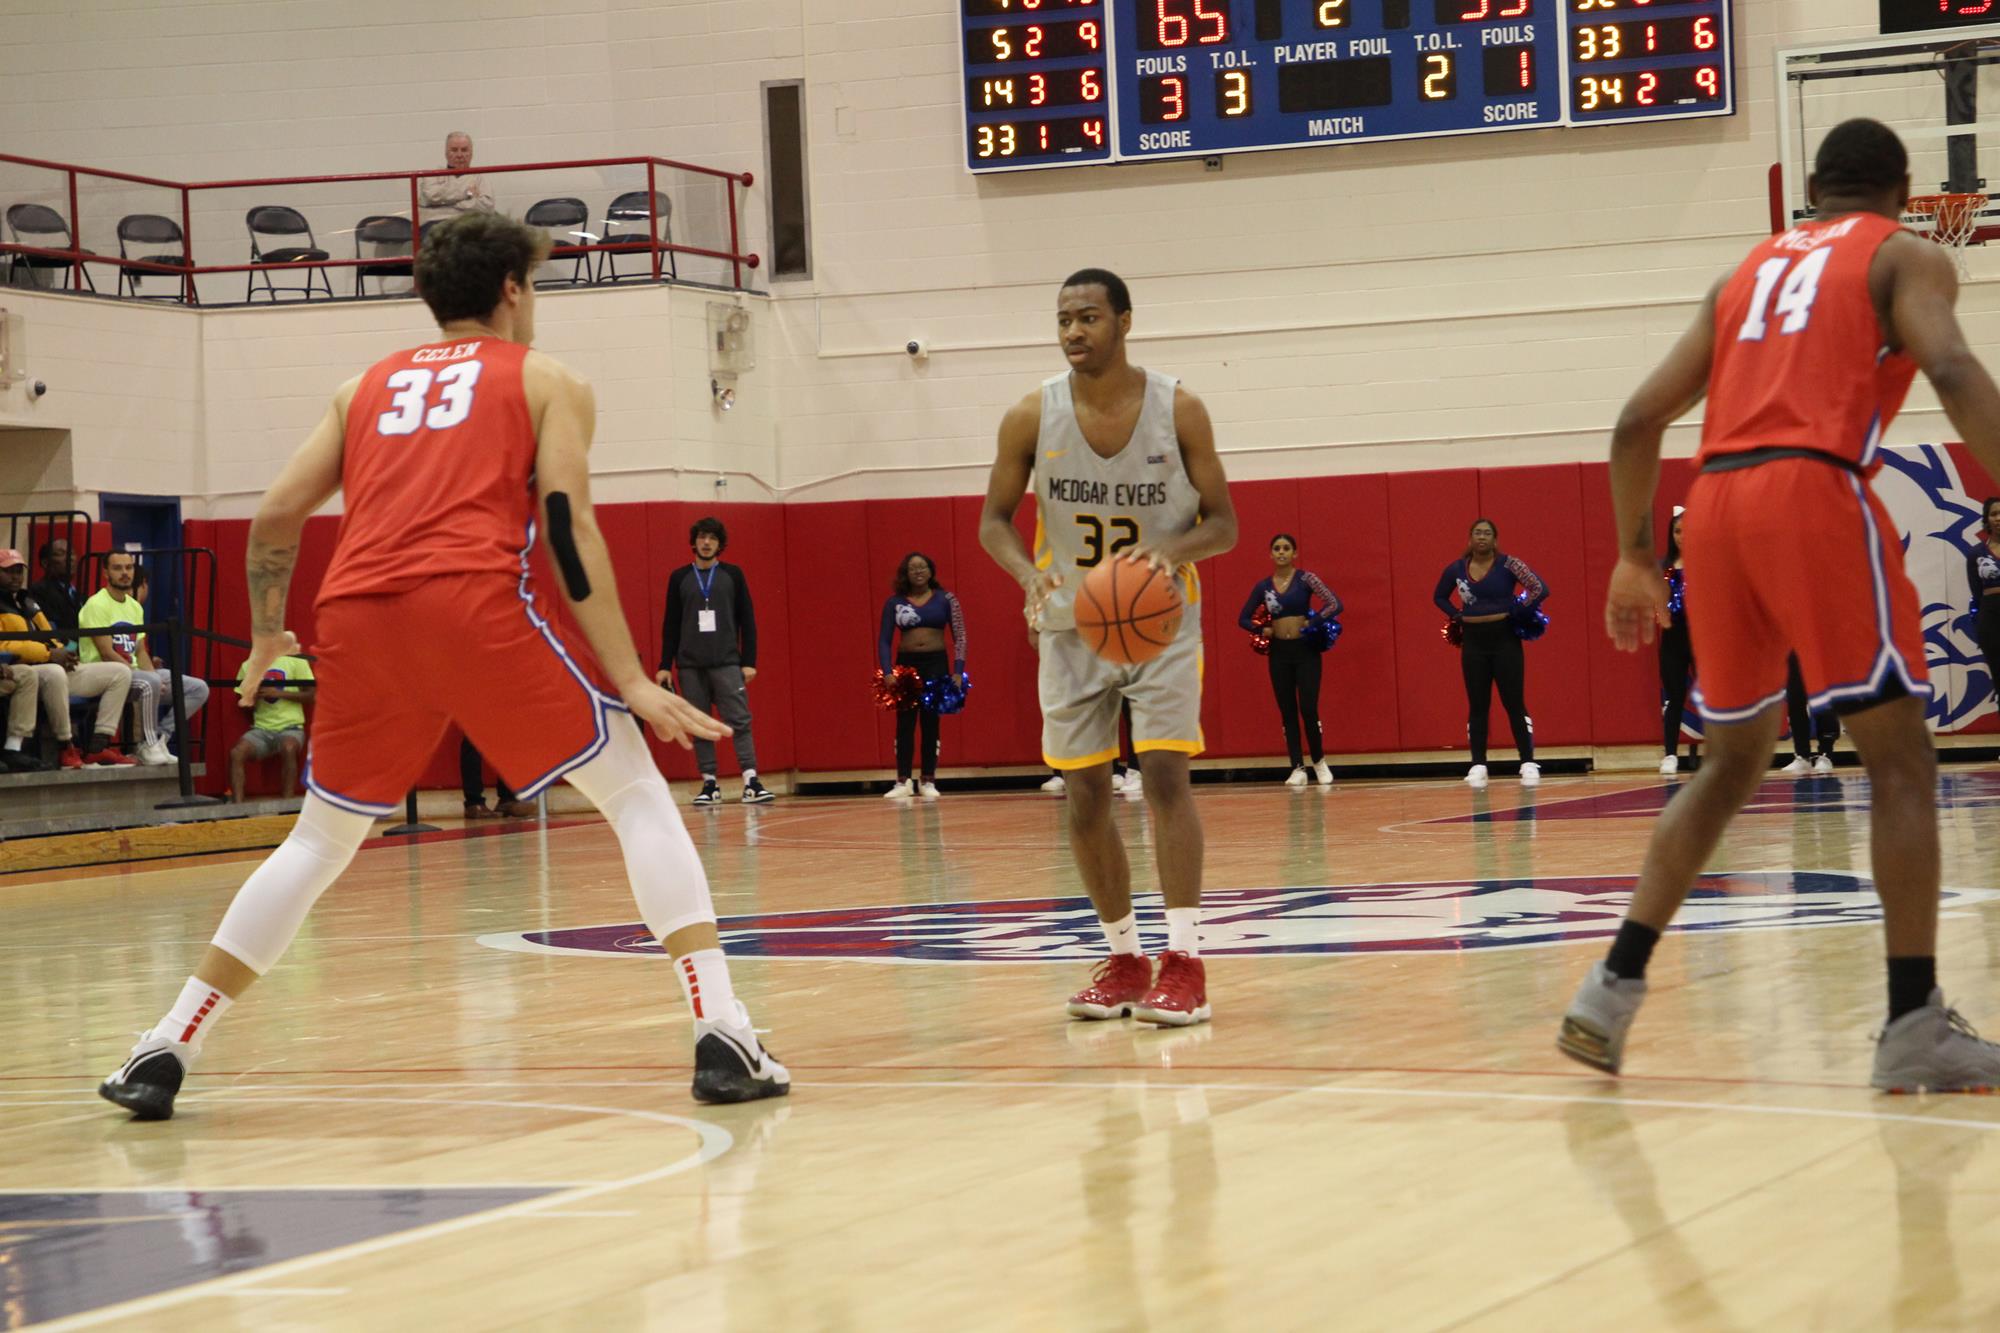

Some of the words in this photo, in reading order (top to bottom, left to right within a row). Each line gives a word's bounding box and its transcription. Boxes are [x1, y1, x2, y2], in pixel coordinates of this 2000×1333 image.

[992, 28, 1011, 60] 5
[1025, 26, 1042, 57] 2
[1078, 21, 1097, 49] 9
[1157, 0, 1224, 46] 65
[1481, 25, 1535, 46] FOULS
[1578, 25, 1620, 60] 33
[1646, 25, 1655, 50] 1
[1694, 17, 1714, 49] 6
[1210, 50, 1257, 69] T.O.L.
[1274, 42, 1337, 63] PLAYER
[1349, 37, 1392, 57] FOUL
[1414, 32, 1462, 51] T.O.L.
[1136, 55, 1187, 76] FOULS
[1424, 55, 1449, 98] 2
[1520, 51, 1529, 87] 1
[984, 78, 1013, 106] 14
[1029, 75, 1045, 105] 3
[1081, 70, 1099, 100] 6
[1161, 78, 1182, 120] 3
[1224, 72, 1246, 115] 3
[1580, 77, 1622, 110] 34
[1637, 72, 1656, 104] 2
[1696, 68, 1716, 96] 9
[1308, 116, 1364, 136] MATCH
[1483, 102, 1538, 122] SCORE
[978, 124, 1015, 157] 33
[1040, 125, 1047, 149] 1
[1083, 121, 1101, 145] 4
[1139, 130, 1192, 151] SCORE
[1738, 245, 1833, 342] 14
[377, 359, 483, 436] 33
[1049, 477, 1109, 505] MEDGAR
[1115, 481, 1167, 507] EVERS
[1075, 514, 1140, 568] 32
